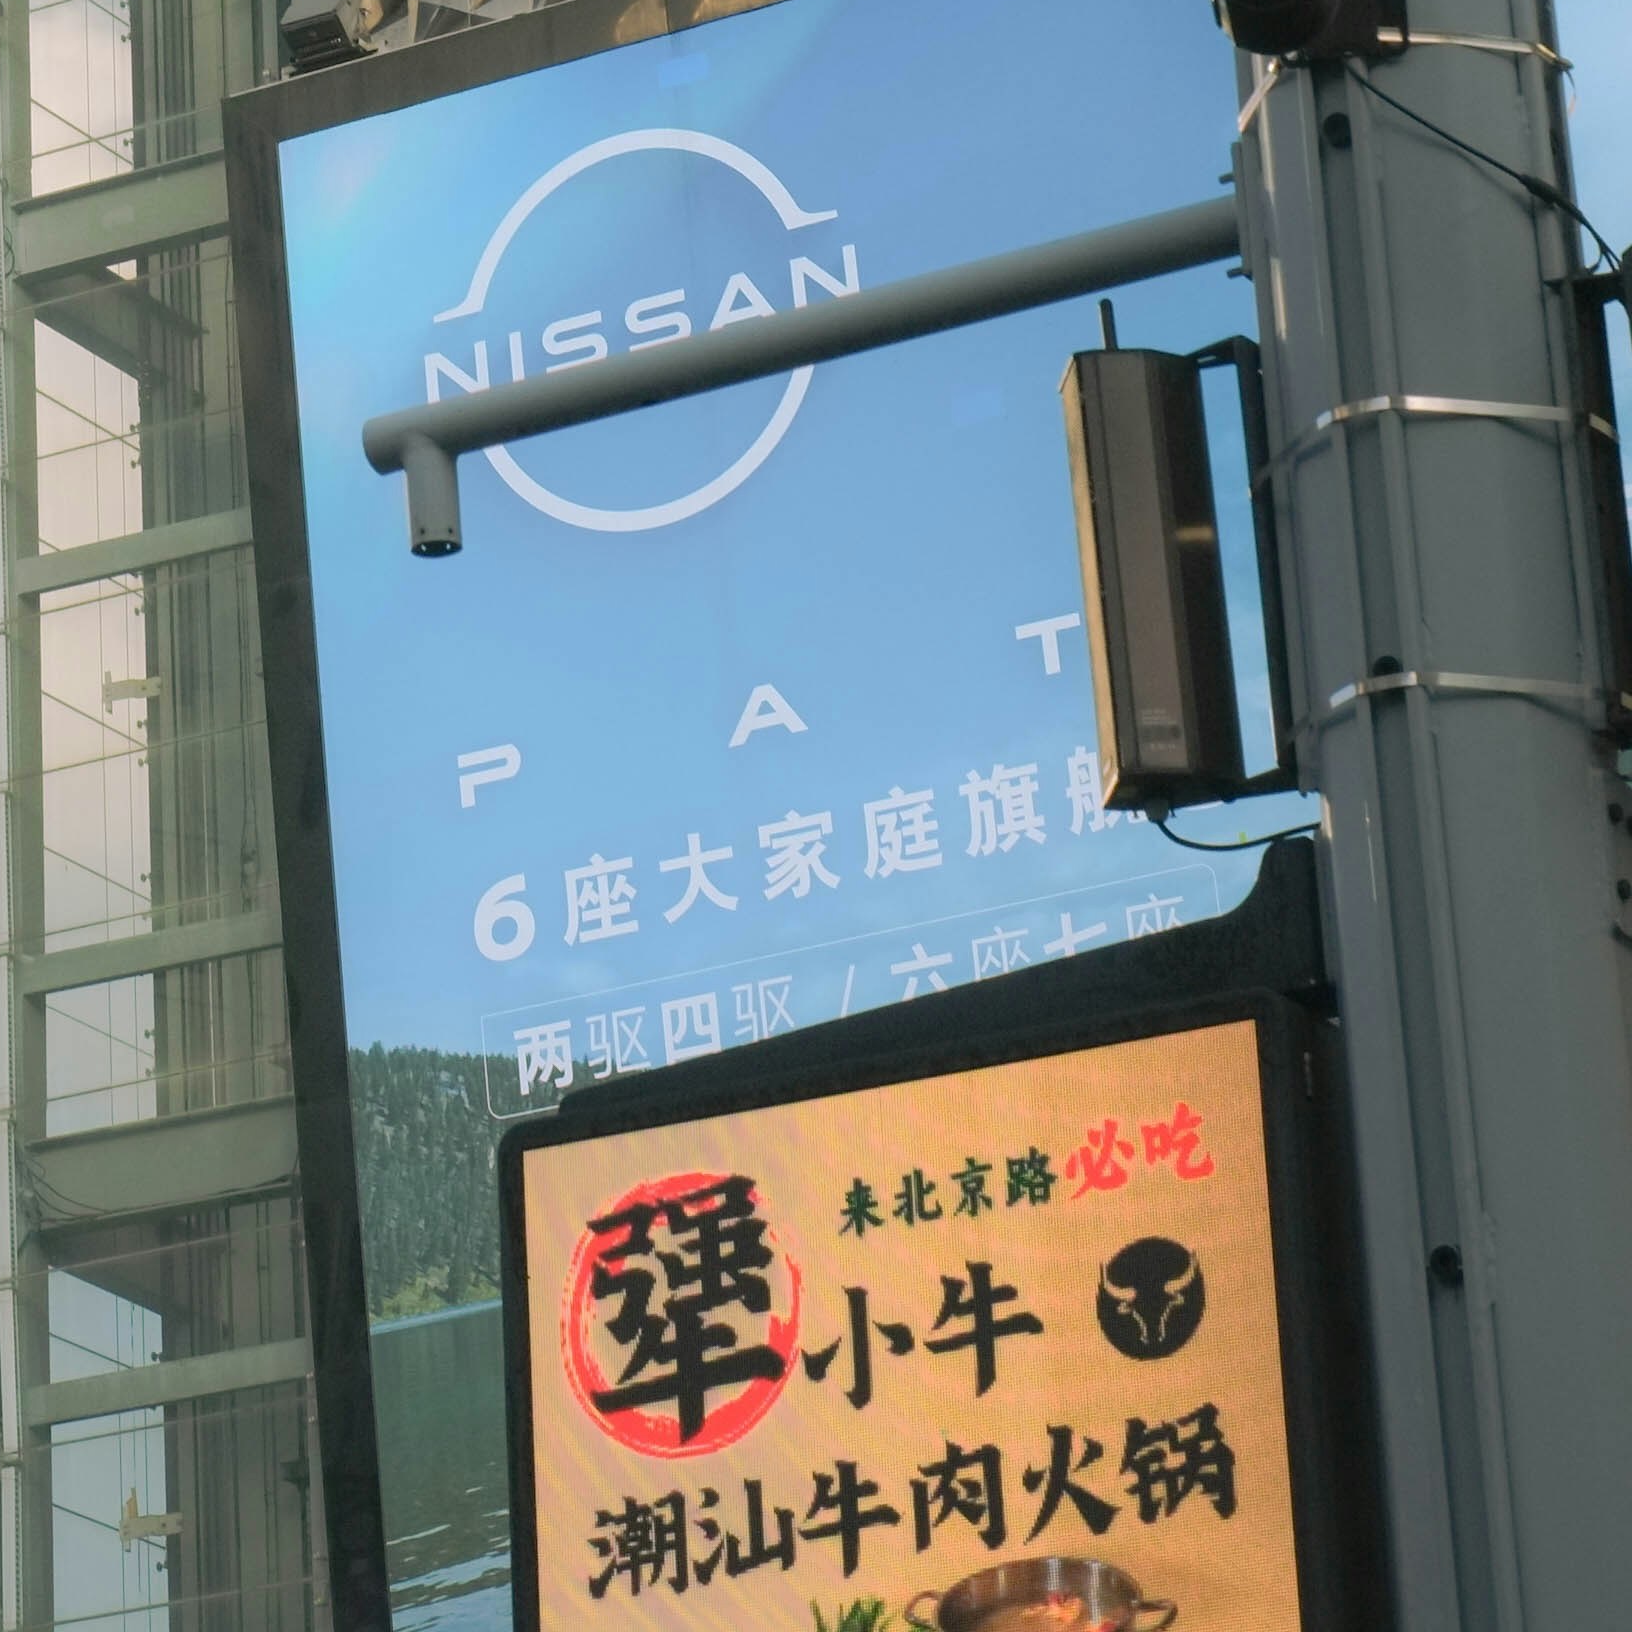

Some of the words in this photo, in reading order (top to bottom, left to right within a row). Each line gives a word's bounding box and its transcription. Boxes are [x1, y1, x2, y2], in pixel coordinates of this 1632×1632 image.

[424, 243, 860, 404] NISSAN
[586, 1402, 1238, 1601] 潮汕牛肉火锅
